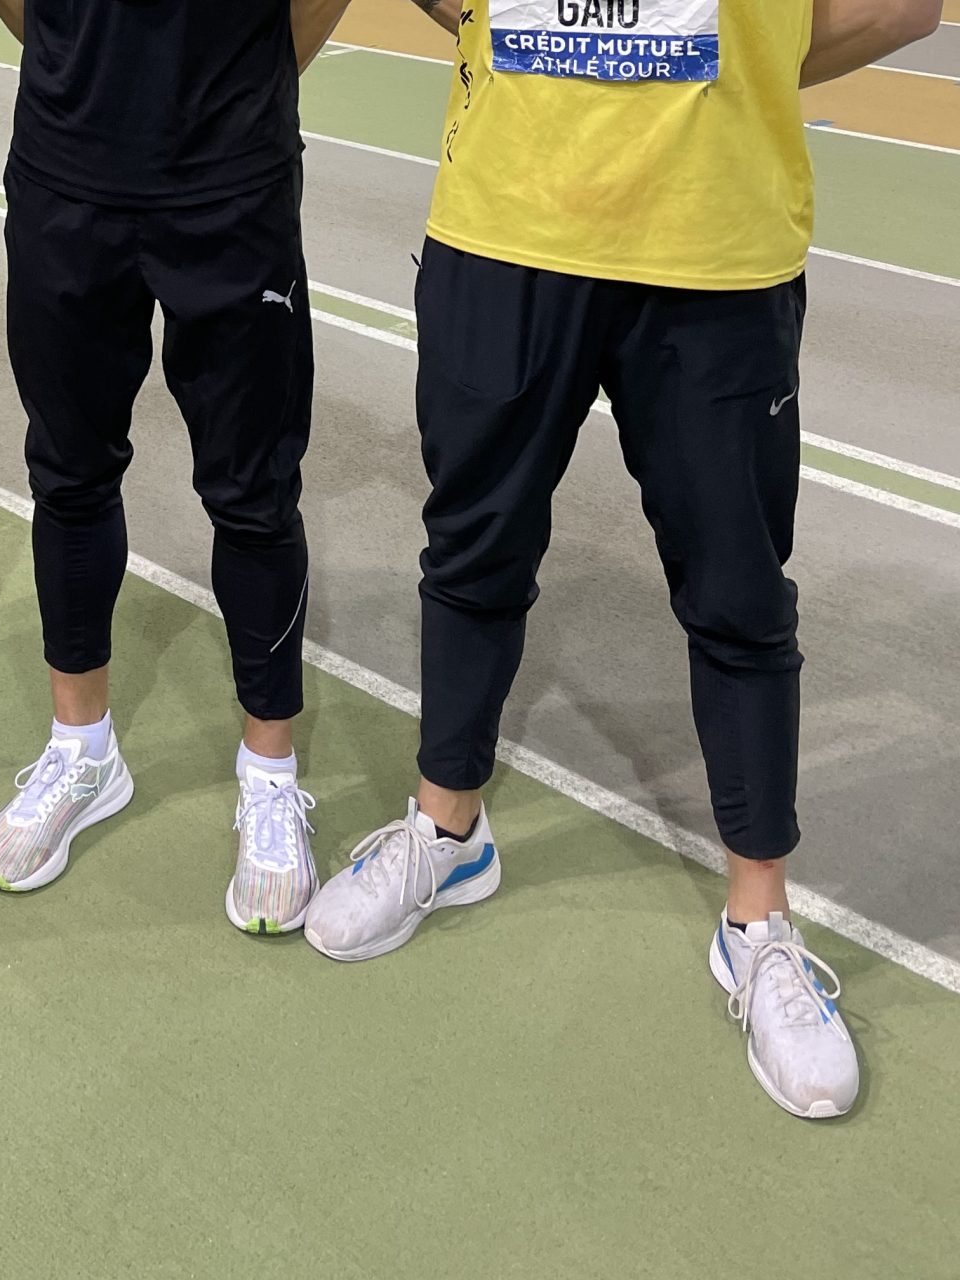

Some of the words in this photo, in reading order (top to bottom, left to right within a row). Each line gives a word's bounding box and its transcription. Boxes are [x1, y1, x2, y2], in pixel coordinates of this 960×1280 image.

[504, 31, 590, 54] CRÉDIT
[597, 38, 701, 57] MUTUEL
[531, 56, 599, 77] ATHLÉ
[606, 62, 671, 78] TOUR
